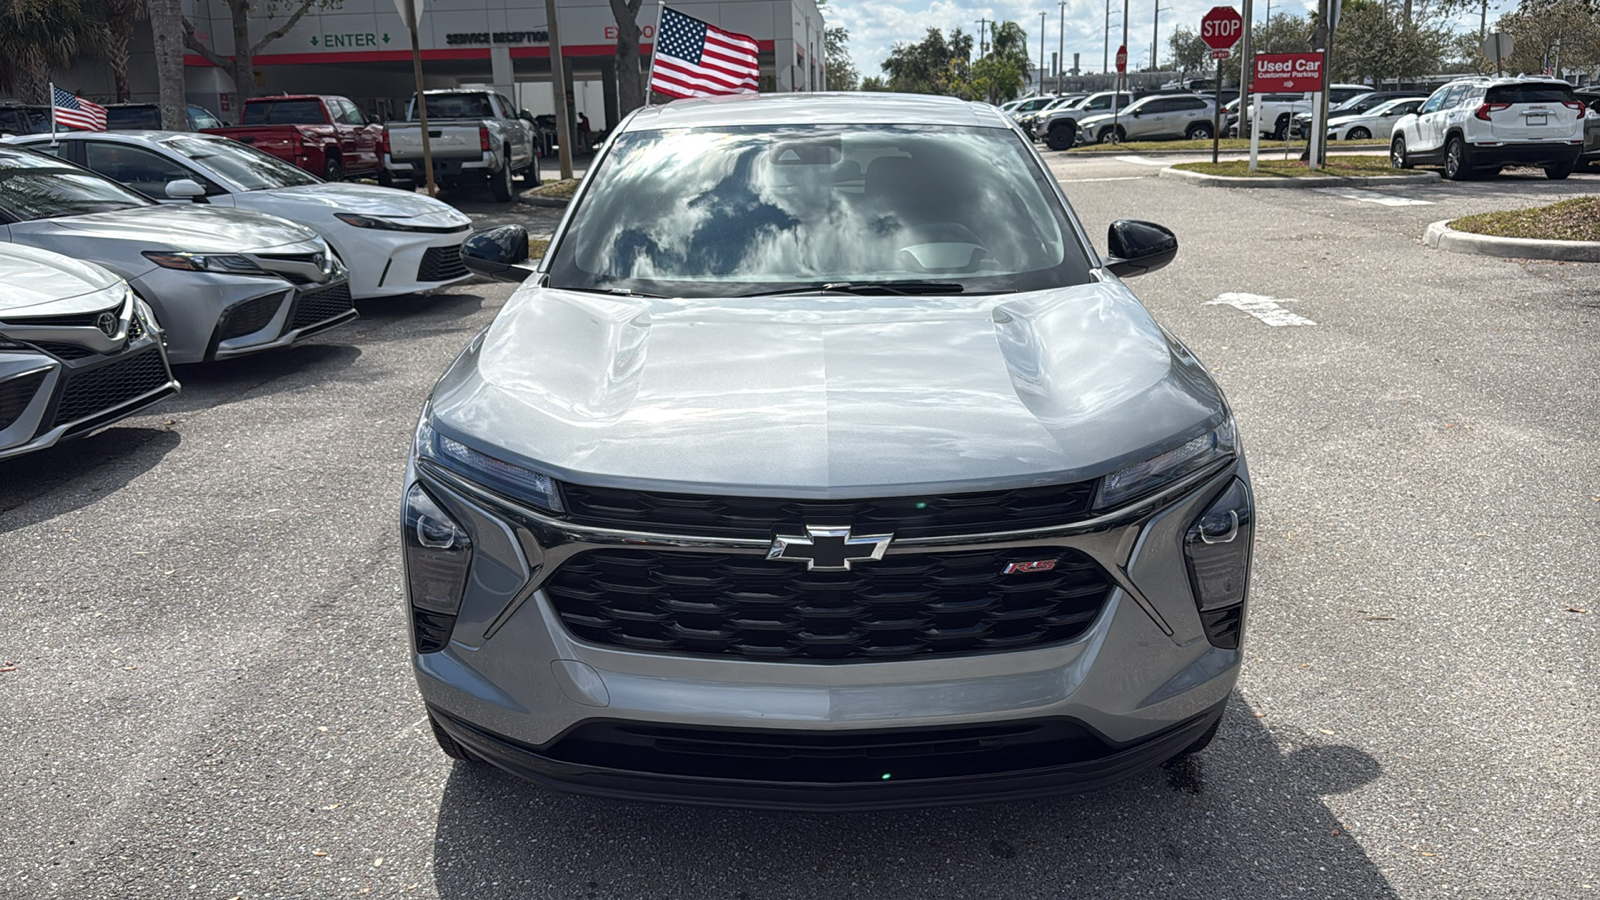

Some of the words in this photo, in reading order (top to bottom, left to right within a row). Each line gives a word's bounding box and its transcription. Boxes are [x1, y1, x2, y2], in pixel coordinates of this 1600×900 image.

[1203, 19, 1240, 37] STOP
[324, 33, 377, 48] ENTER
[445, 32, 491, 44] SERVICE
[1257, 60, 1292, 72] Used
[1295, 59, 1321, 71] Car
[1292, 71, 1319, 79] Parking
[1003, 559, 1057, 574] RS
